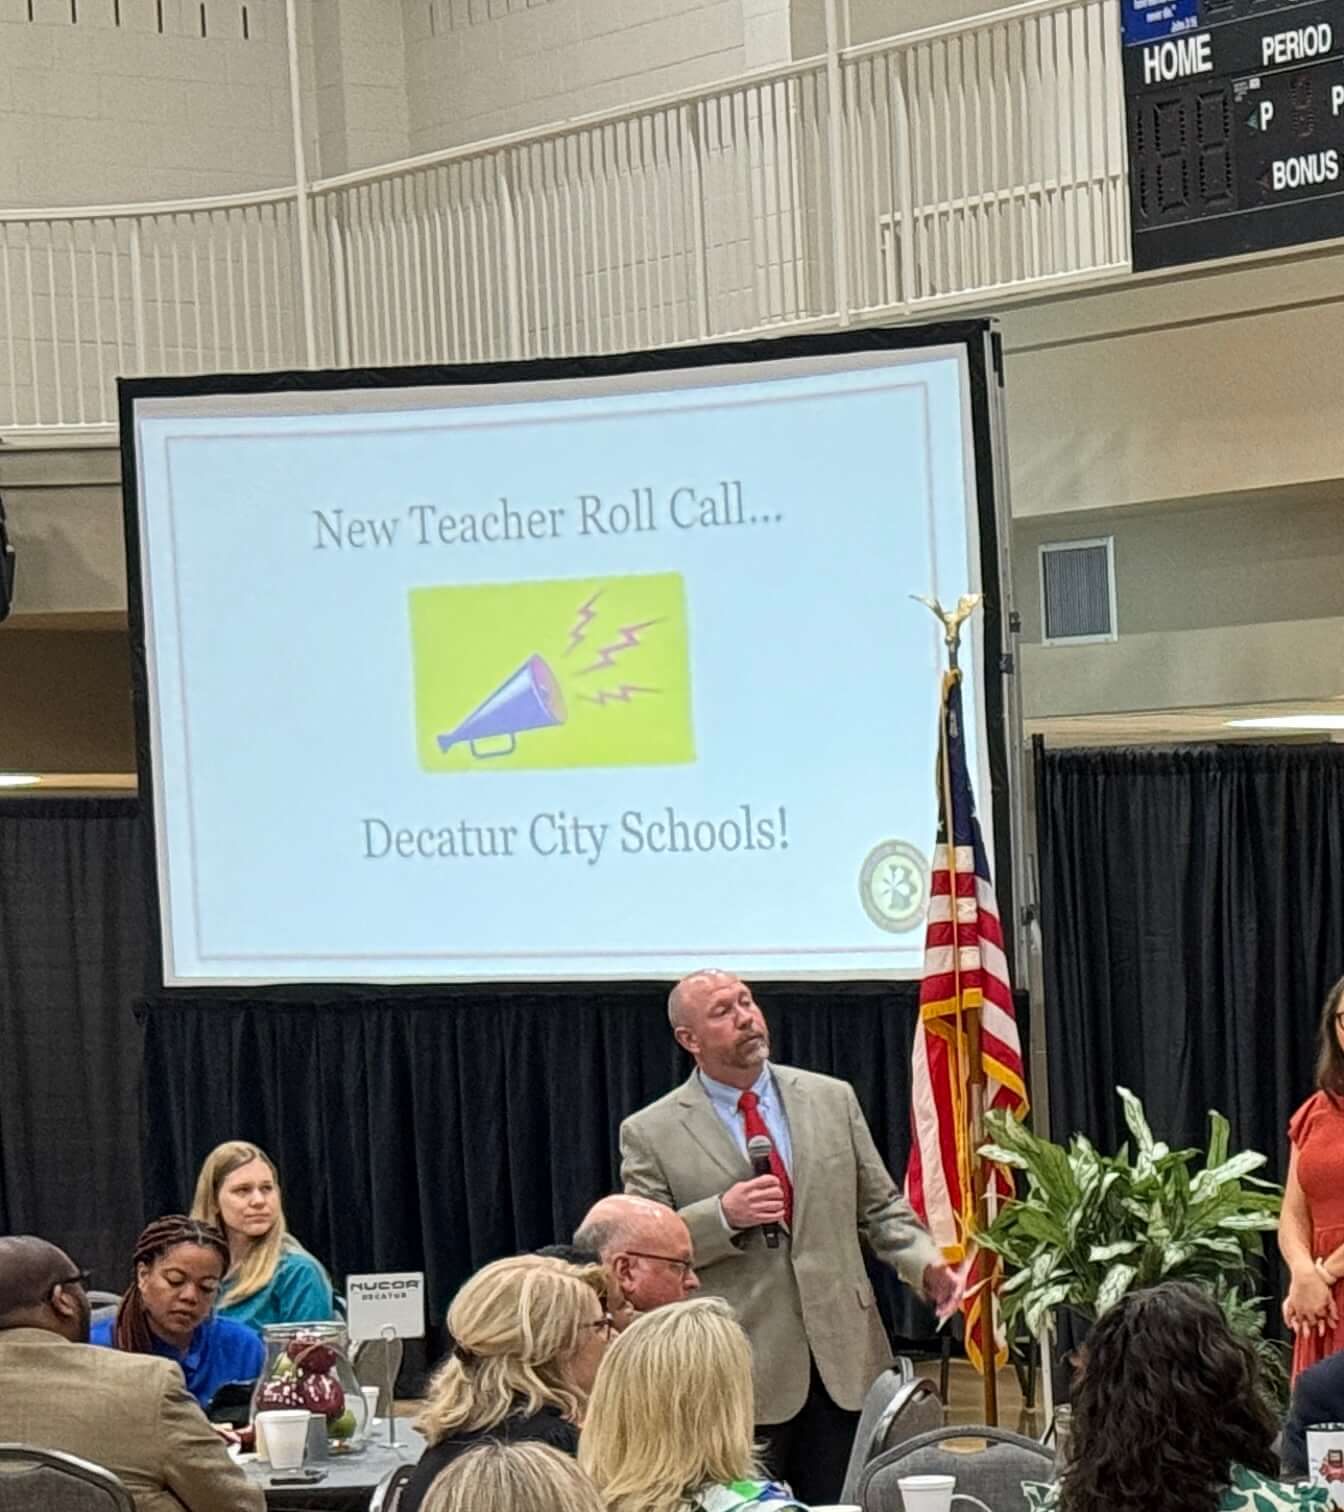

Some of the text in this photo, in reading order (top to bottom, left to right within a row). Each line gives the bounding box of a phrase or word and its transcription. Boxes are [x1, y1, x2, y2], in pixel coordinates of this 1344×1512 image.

[1143, 33, 1213, 85] HOME
[1261, 23, 1332, 66] PERIOD
[1260, 101, 1273, 131] P
[1332, 85, 1344, 116] P
[1272, 150, 1339, 191] BONUS
[312, 480, 783, 550] New Teacher Roll Call...
[362, 803, 789, 867] Decatur City Schools!
[350, 1279, 420, 1292] NUCOR
[361, 1291, 407, 1301] DECATUR
